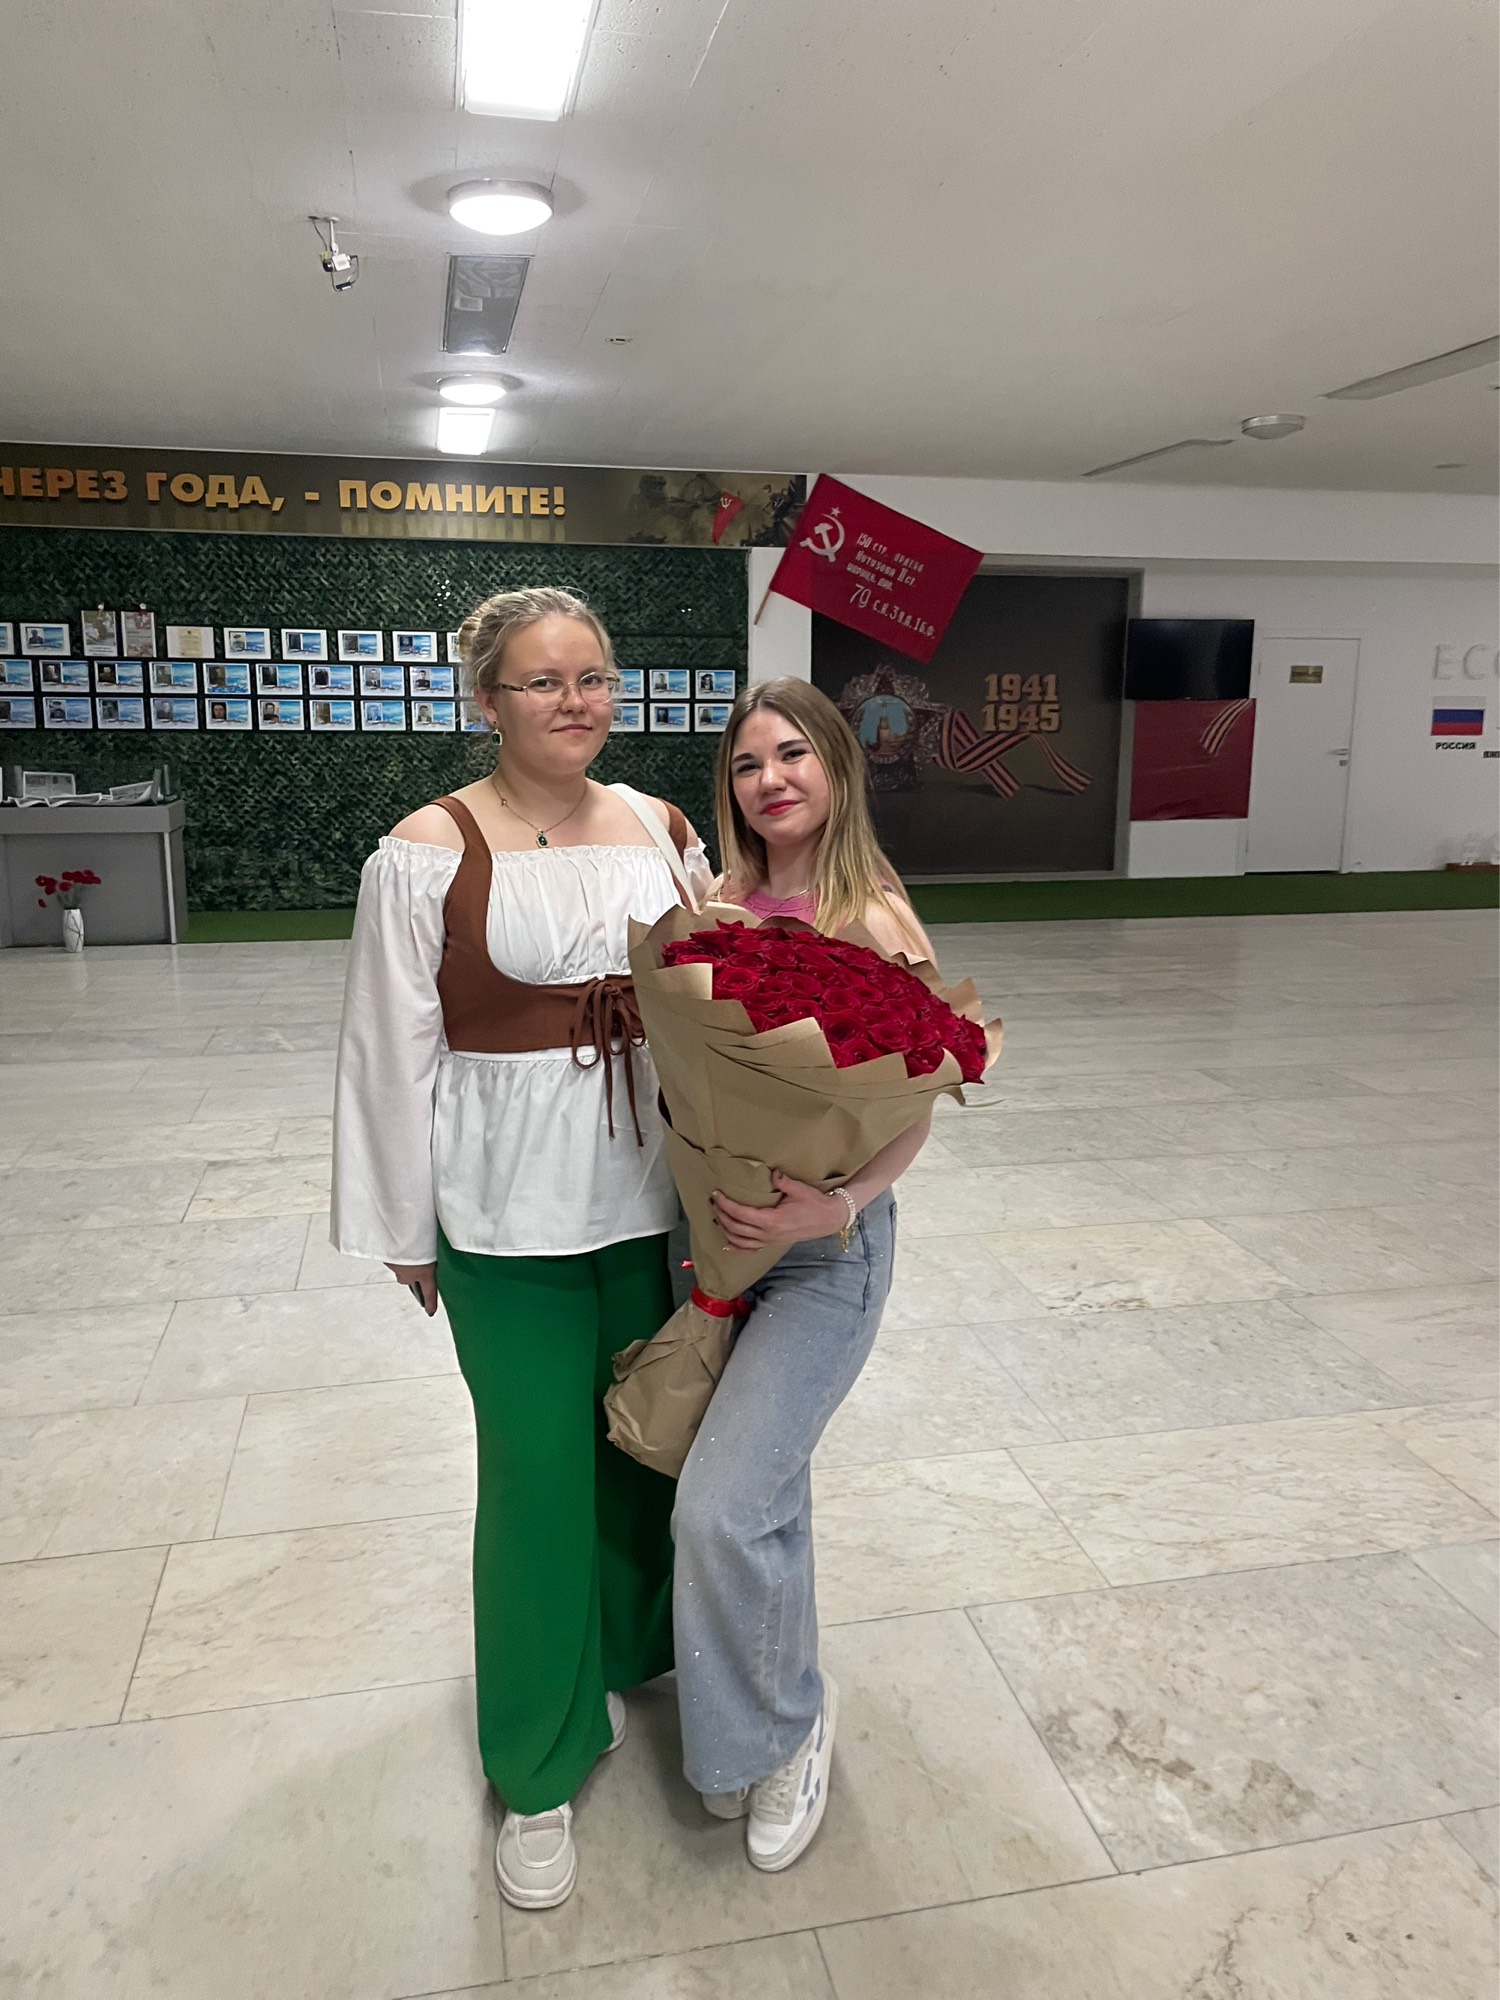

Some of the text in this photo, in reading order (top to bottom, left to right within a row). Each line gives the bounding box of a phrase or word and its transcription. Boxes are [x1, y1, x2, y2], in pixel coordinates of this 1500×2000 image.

[145, 472, 285, 511] ГОДА,
[338, 479, 566, 516] ПОМНИТЕ!
[856, 532, 873, 548] 150
[849, 583, 872, 608] 79
[1432, 644, 1500, 680] ЕС
[984, 673, 1059, 702] 1941
[982, 703, 1061, 732] 1945
[1435, 742, 1476, 750] РОССИЯ
